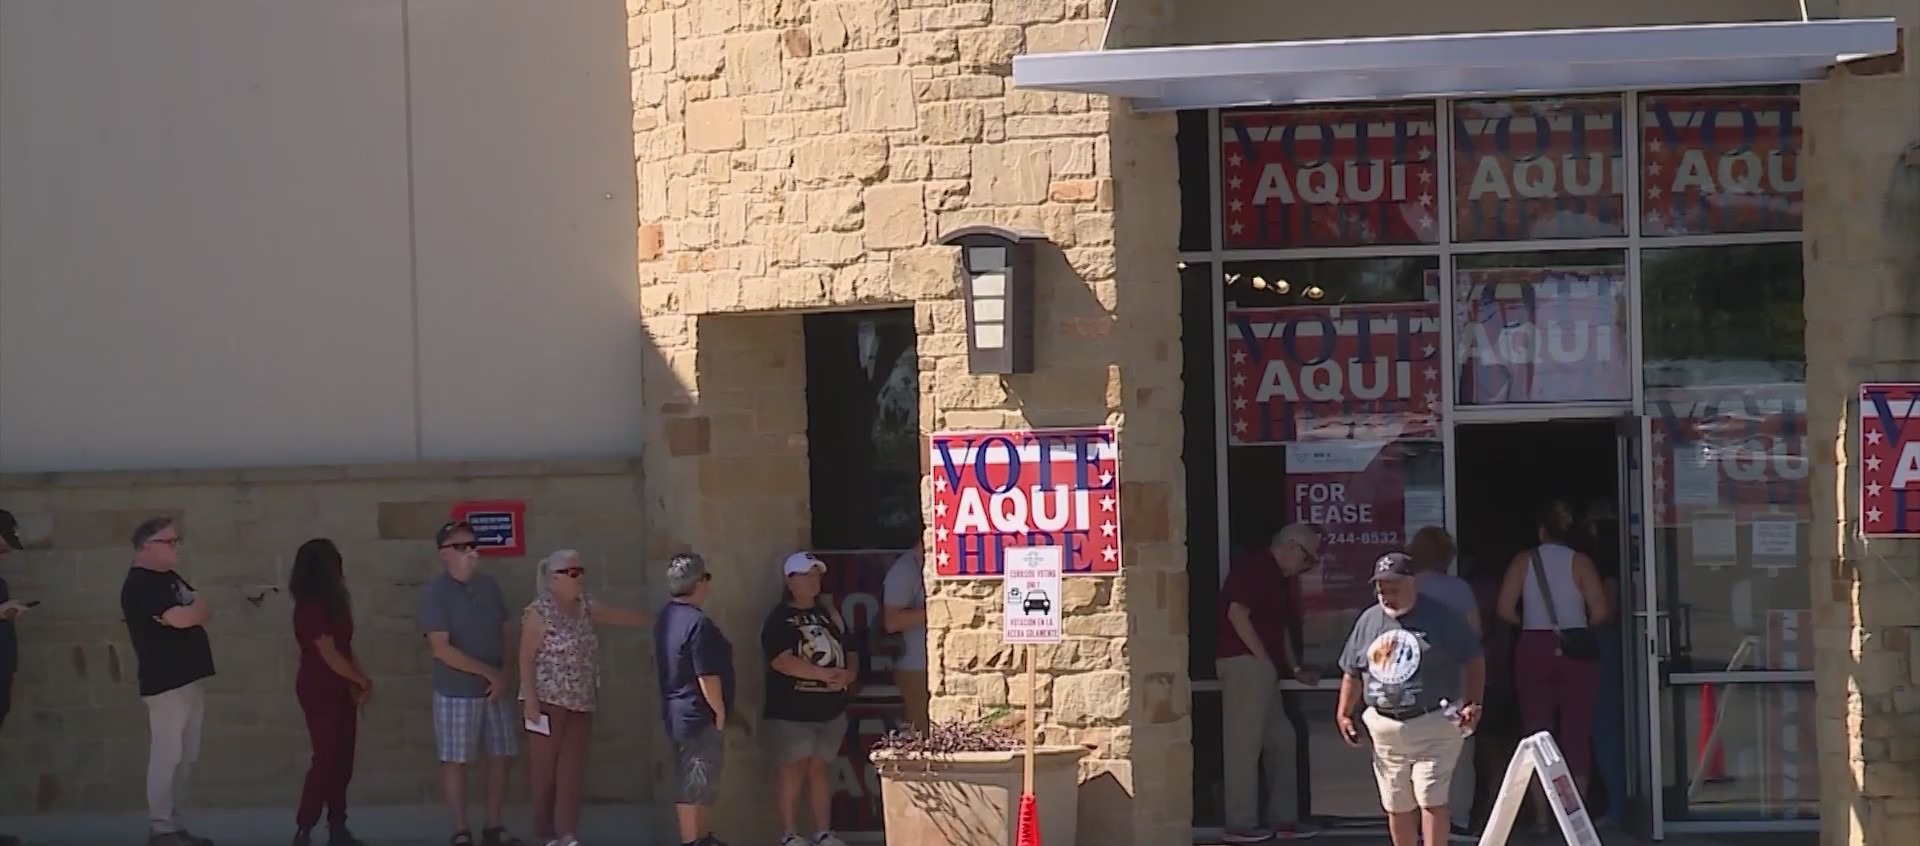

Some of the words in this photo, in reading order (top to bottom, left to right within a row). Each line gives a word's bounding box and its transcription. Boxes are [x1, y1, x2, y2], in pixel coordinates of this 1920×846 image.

[1233, 116, 1434, 168] VOTE
[1655, 102, 1802, 156] VOT
[1252, 159, 1407, 205] AQUI
[1671, 148, 1803, 196] AQU
[1237, 312, 1438, 366] VOTE
[1256, 356, 1412, 403] AQUI
[933, 434, 1116, 494] VOTE
[953, 483, 1091, 536] AQUI
[1295, 483, 1345, 503] FOR
[1296, 504, 1374, 525] LEASE
